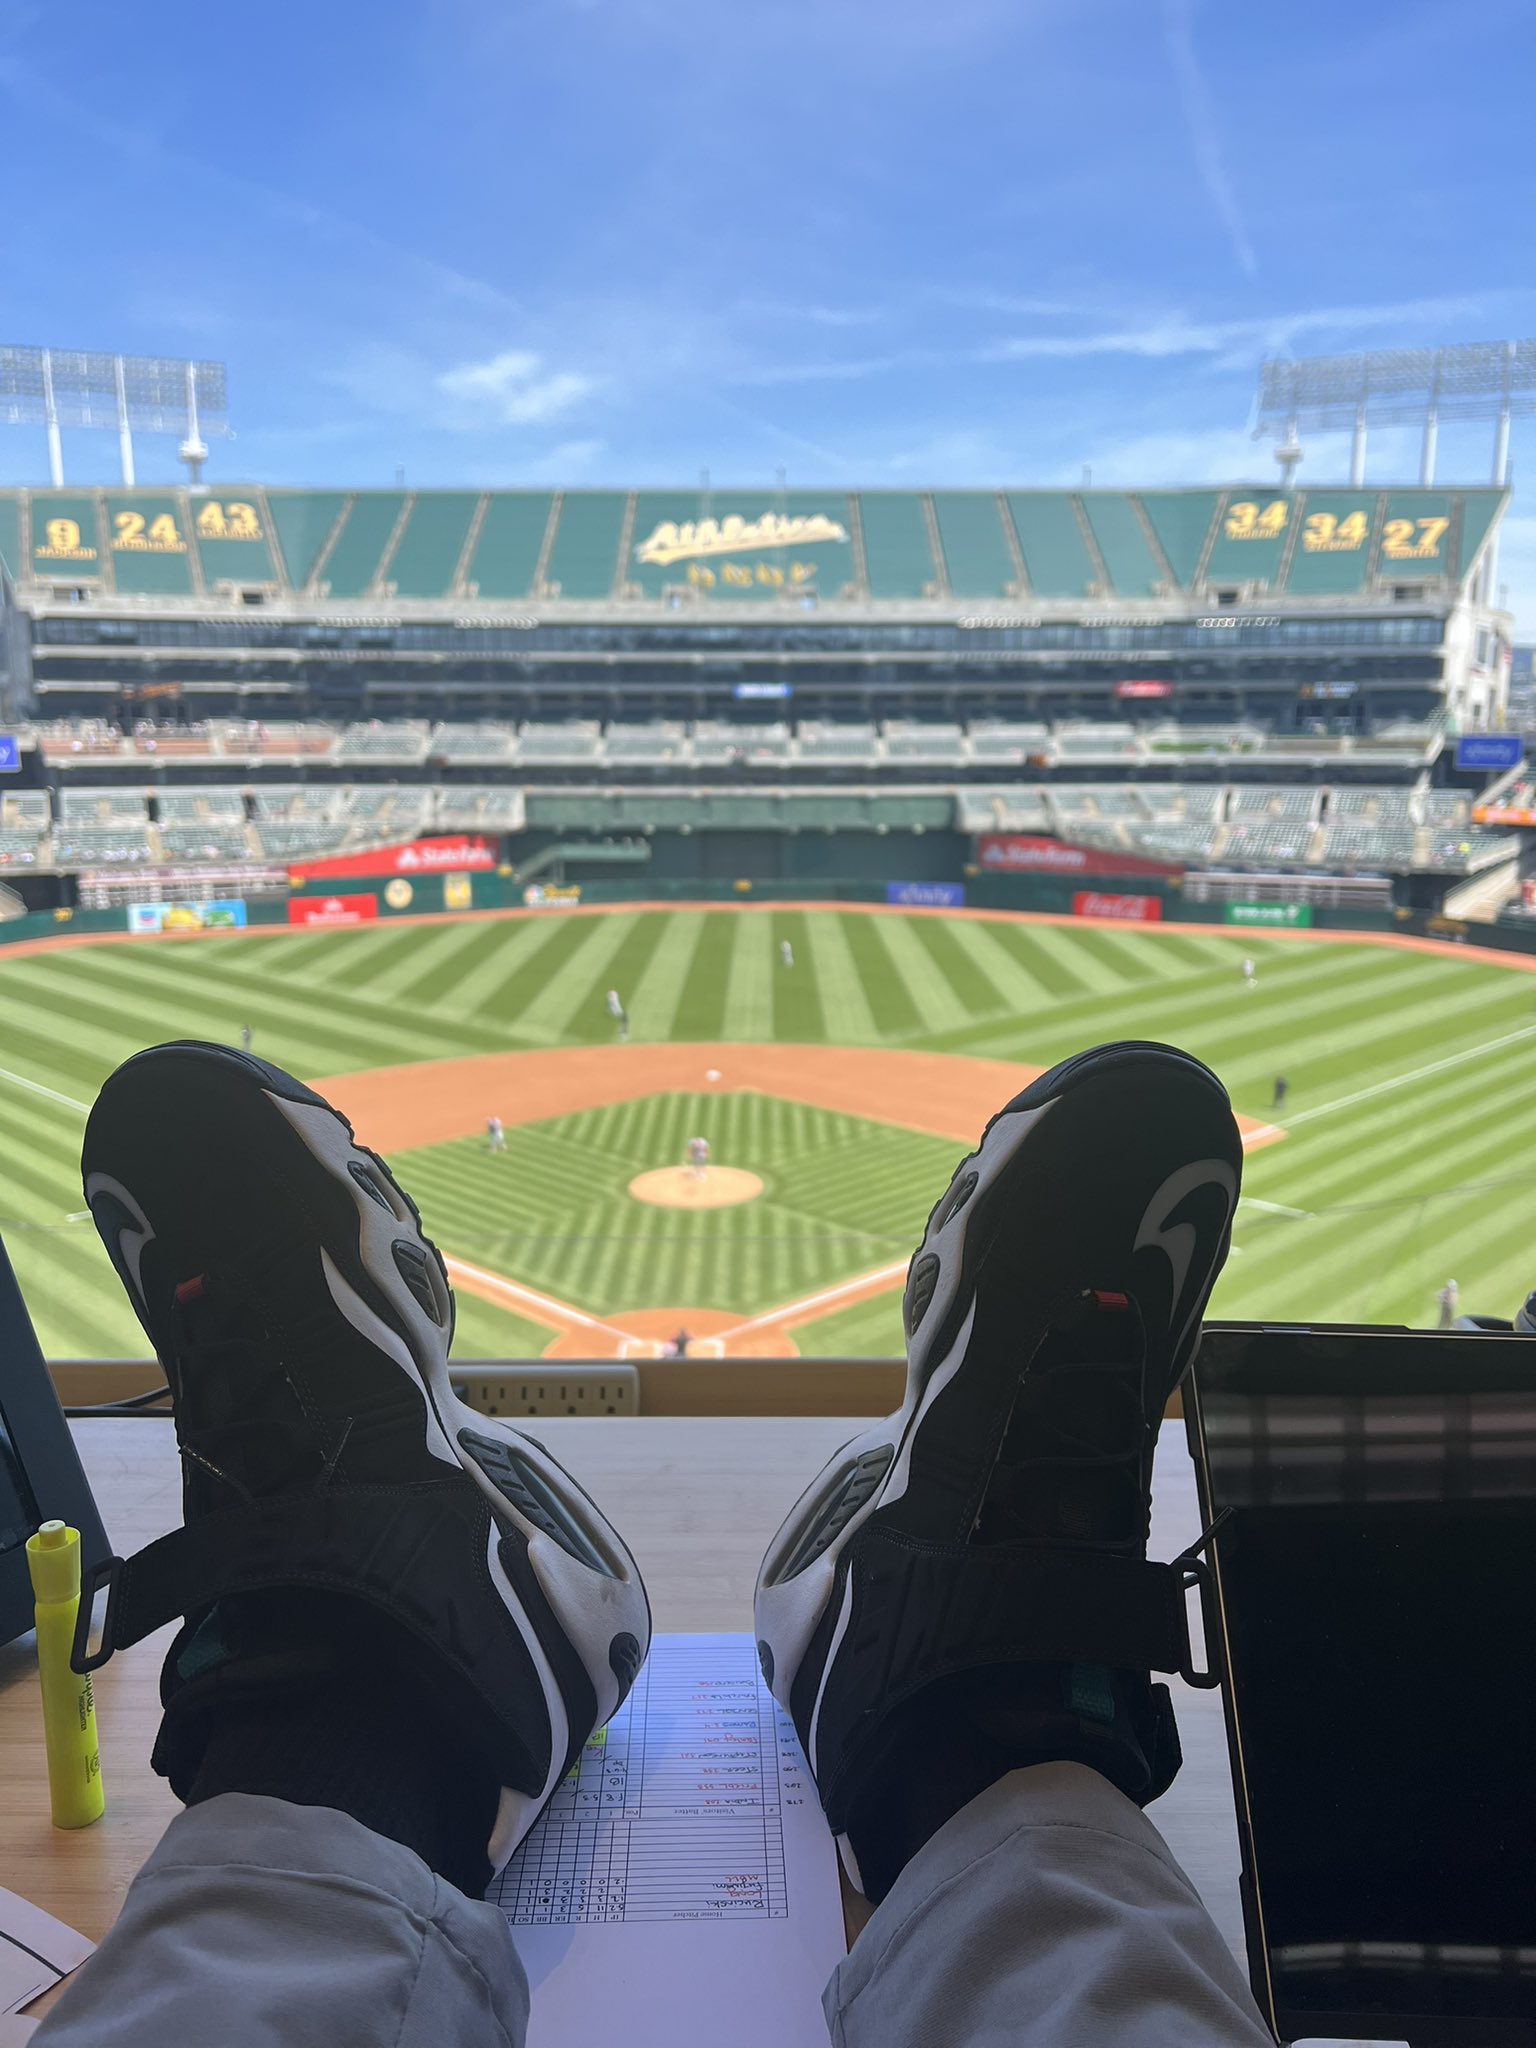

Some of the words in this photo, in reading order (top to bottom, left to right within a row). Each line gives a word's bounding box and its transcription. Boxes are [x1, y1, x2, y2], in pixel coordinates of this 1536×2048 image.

[114, 511, 181, 545] 24
[198, 501, 260, 533] 43
[1225, 500, 1289, 531] 34
[1302, 511, 1369, 545] 34
[46, 518, 80, 550] 9
[1382, 517, 1449, 551] 27
